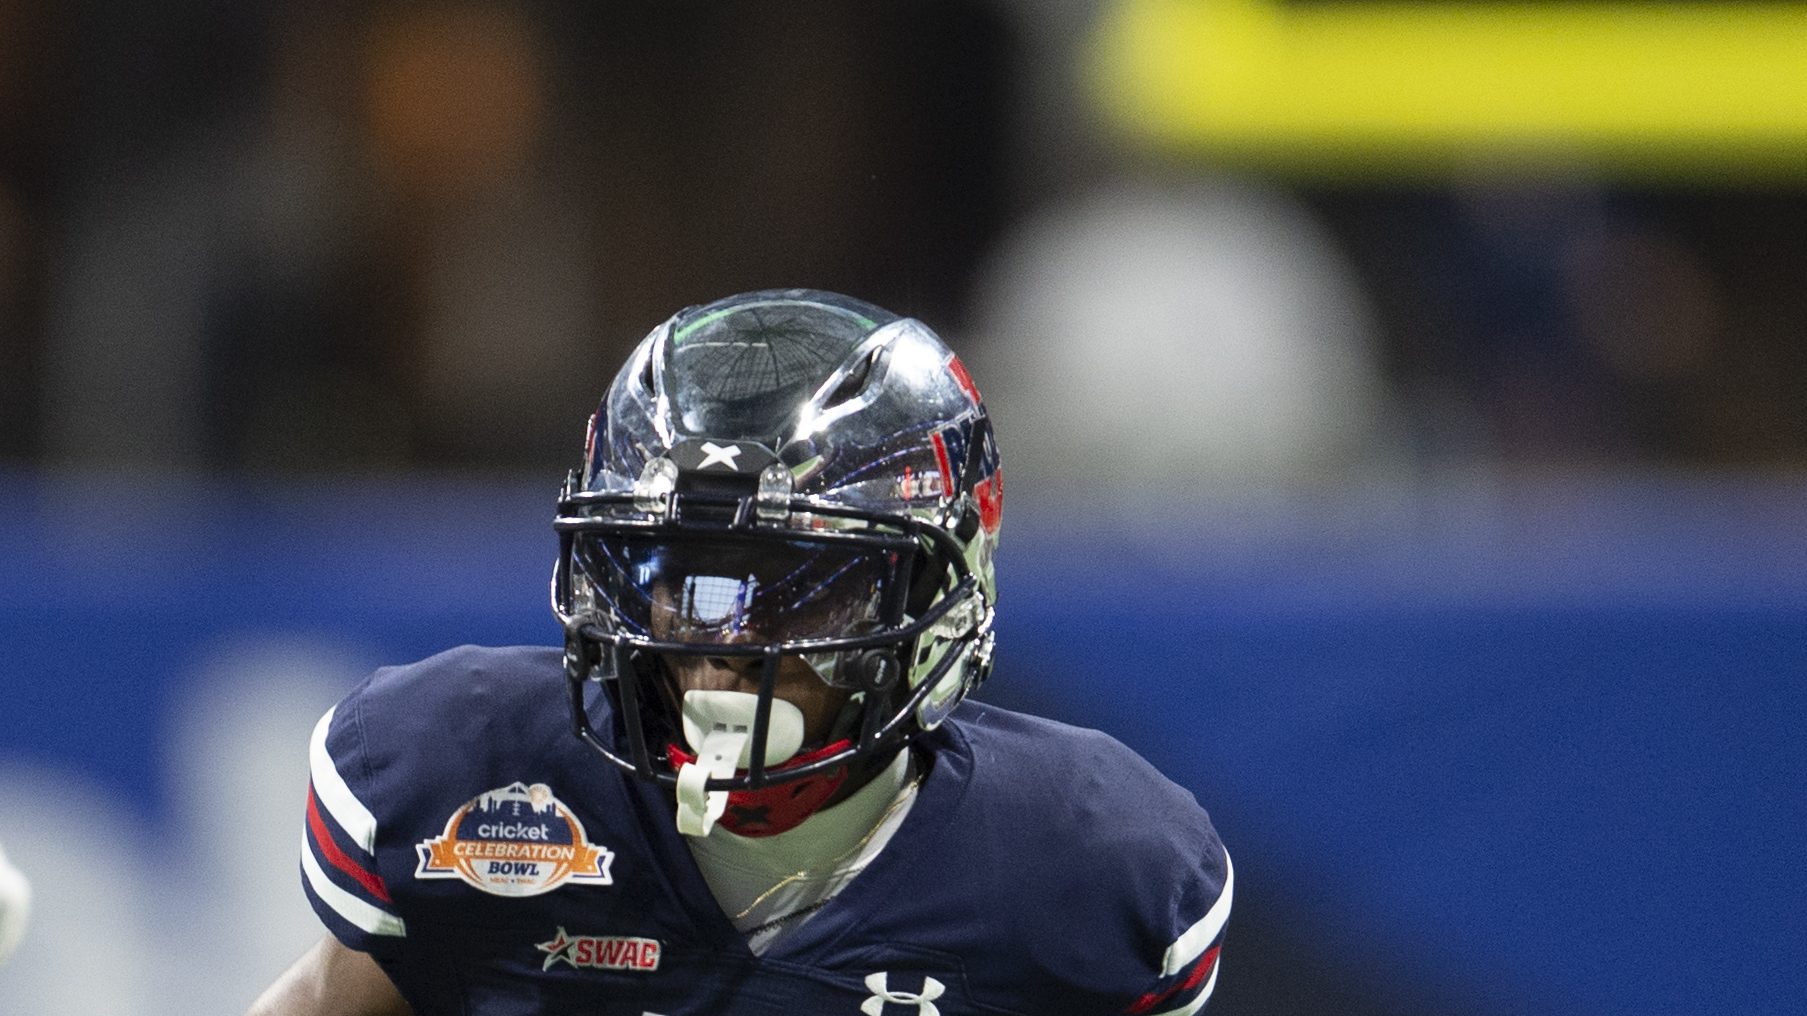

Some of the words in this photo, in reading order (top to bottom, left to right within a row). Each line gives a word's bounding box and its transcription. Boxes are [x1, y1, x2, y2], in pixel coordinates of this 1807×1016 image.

[478, 821, 549, 841] cricket
[453, 841, 575, 861] CELEBRATION
[487, 861, 540, 876] BOWL
[575, 938, 658, 971] SWAC
